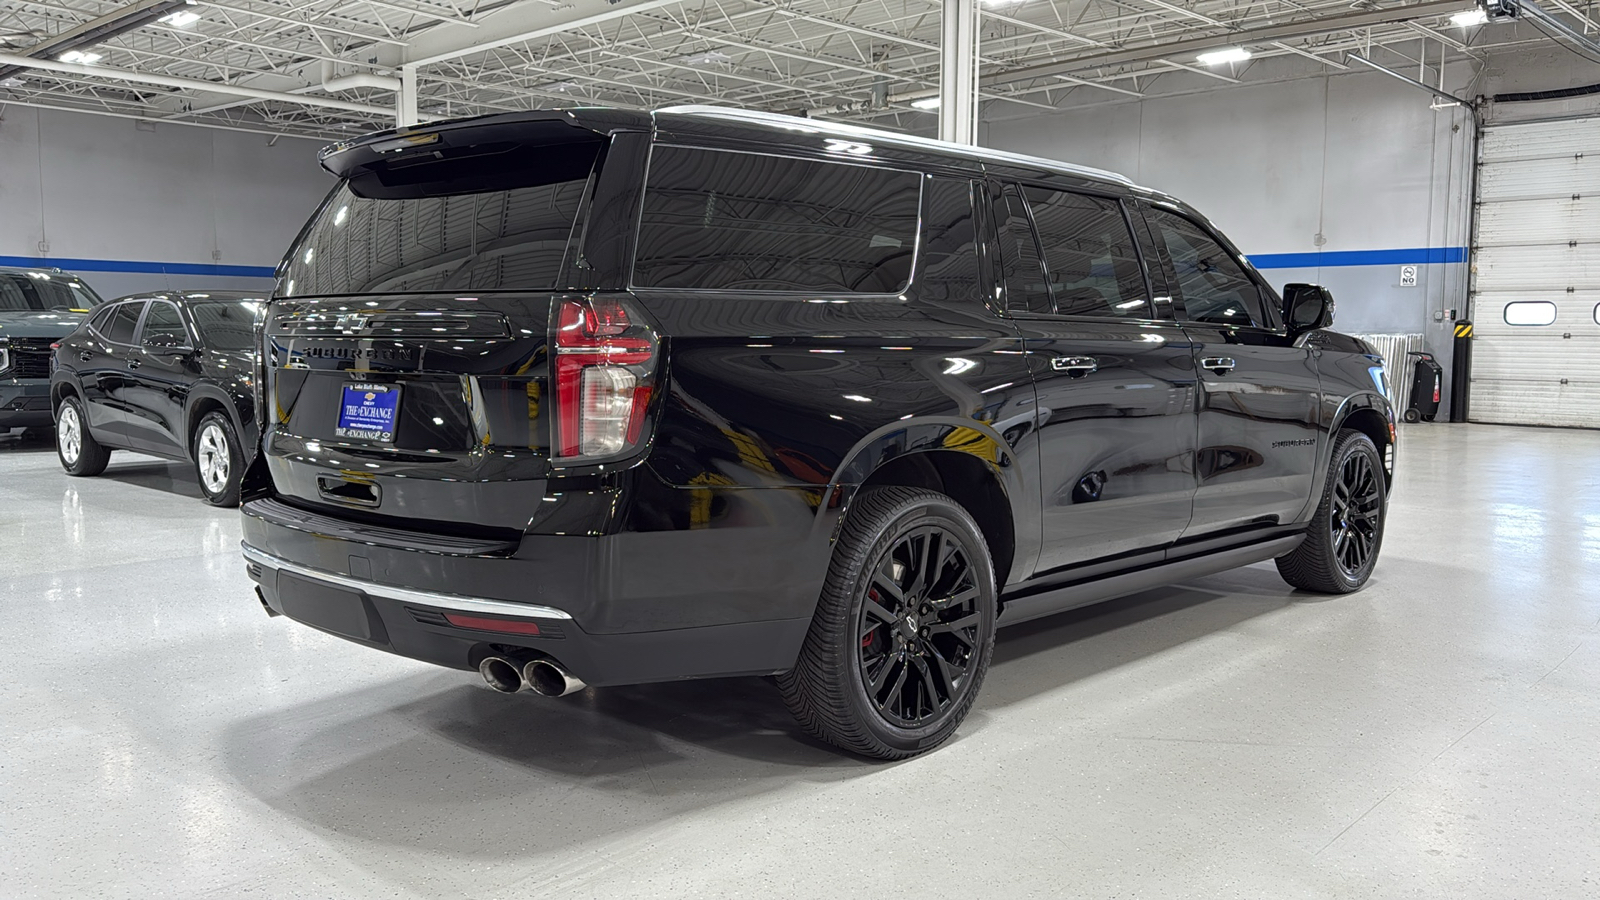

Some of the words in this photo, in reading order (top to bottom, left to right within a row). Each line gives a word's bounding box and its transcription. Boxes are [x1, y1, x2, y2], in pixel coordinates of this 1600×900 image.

[303, 347, 412, 360] SUBURBAN
[346, 405, 358, 416] THE
[360, 406, 392, 419] EXCHANGE
[1272, 438, 1316, 449] SUBURBAN
